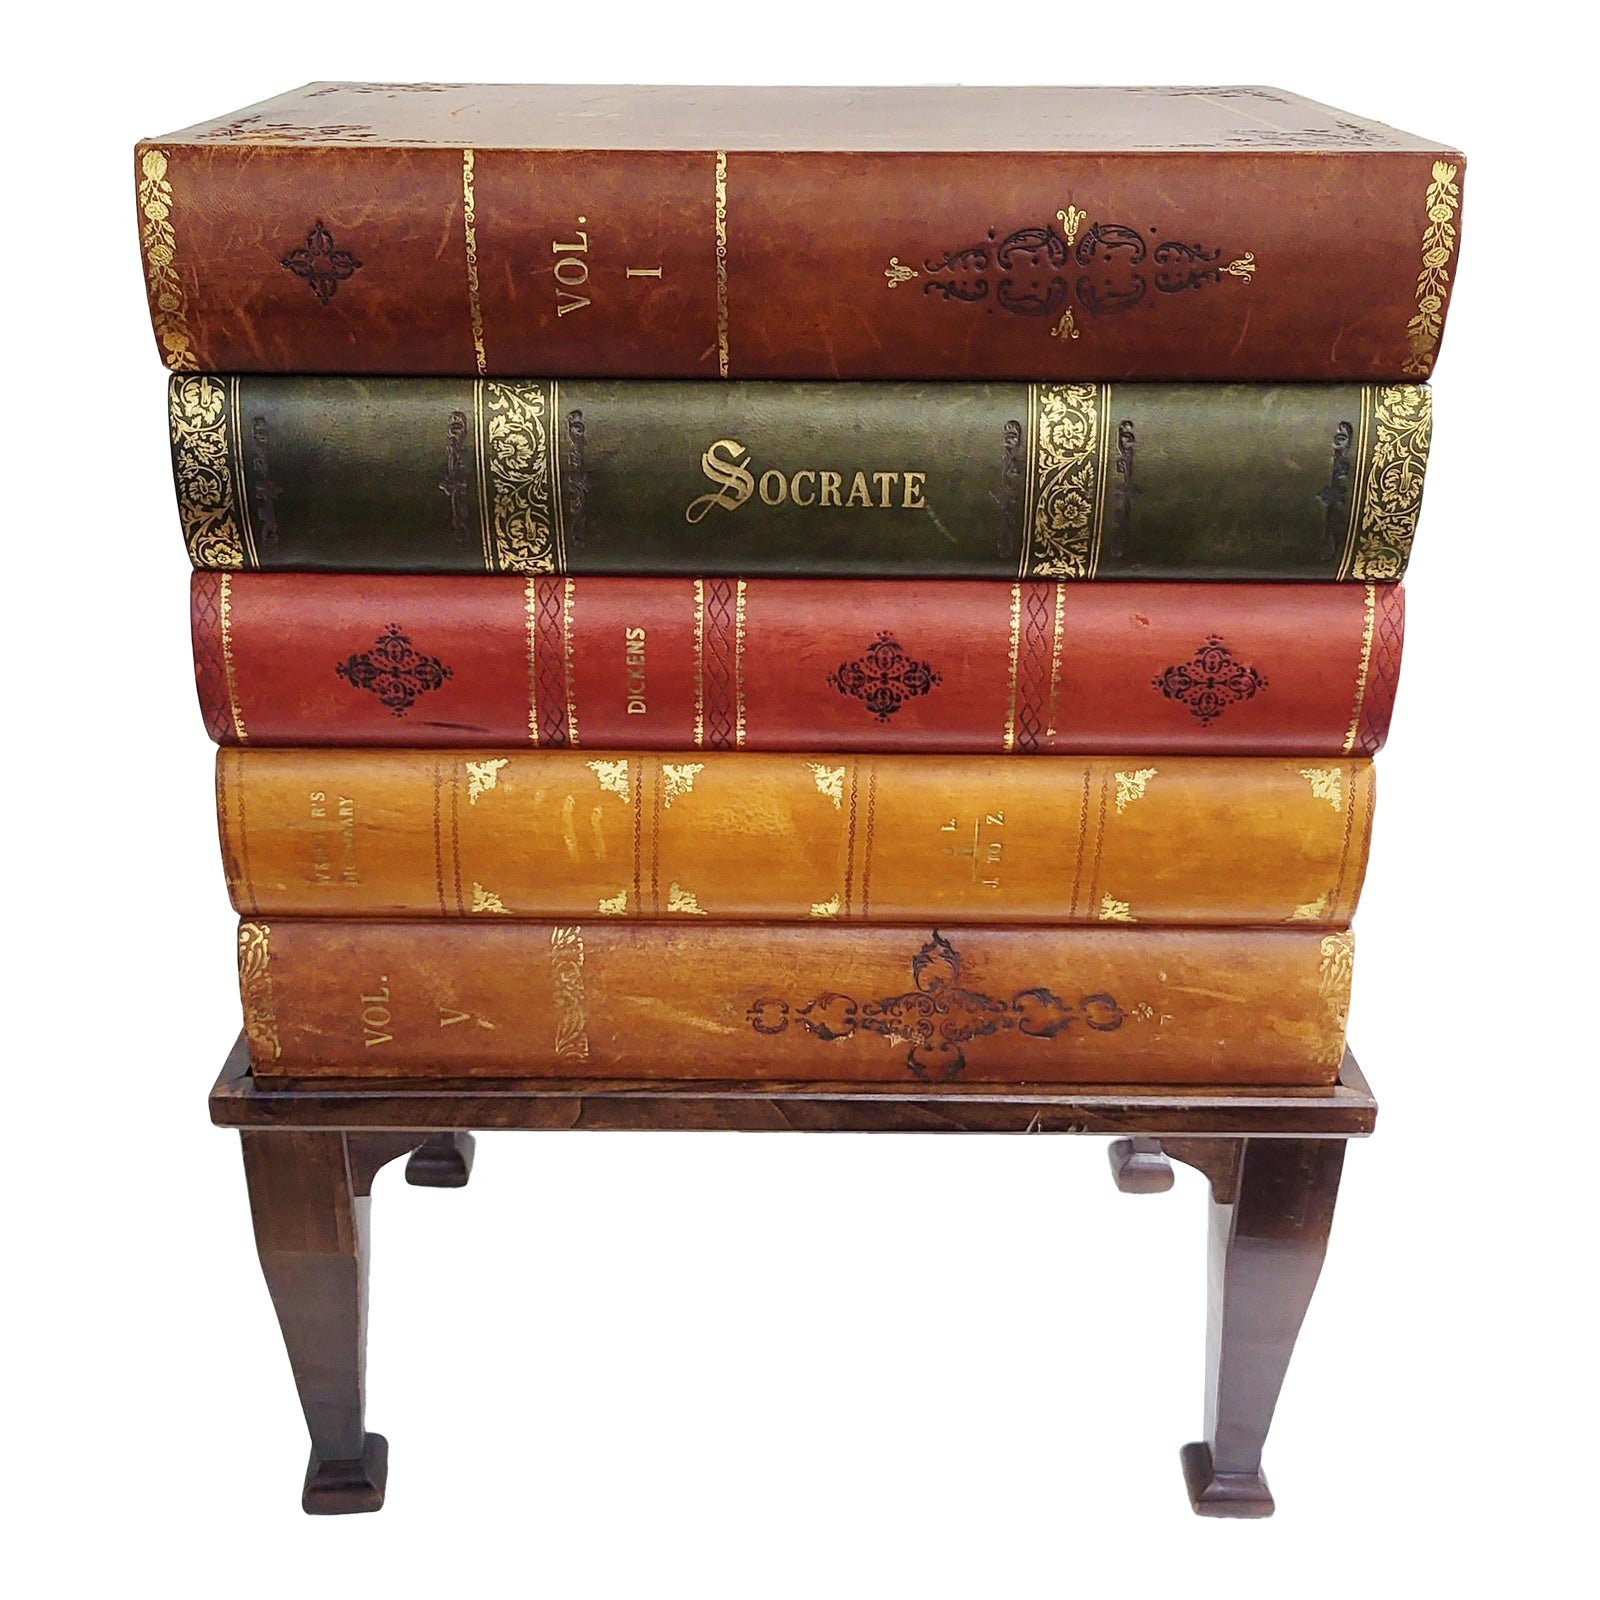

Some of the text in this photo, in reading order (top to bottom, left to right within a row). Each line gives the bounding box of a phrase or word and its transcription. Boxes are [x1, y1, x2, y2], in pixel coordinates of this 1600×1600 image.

[552, 215, 592, 318] VOL.
[625, 626, 647, 715] DICKENS
[360, 975, 394, 1048] VOL.
[439, 1007, 472, 1028] V
